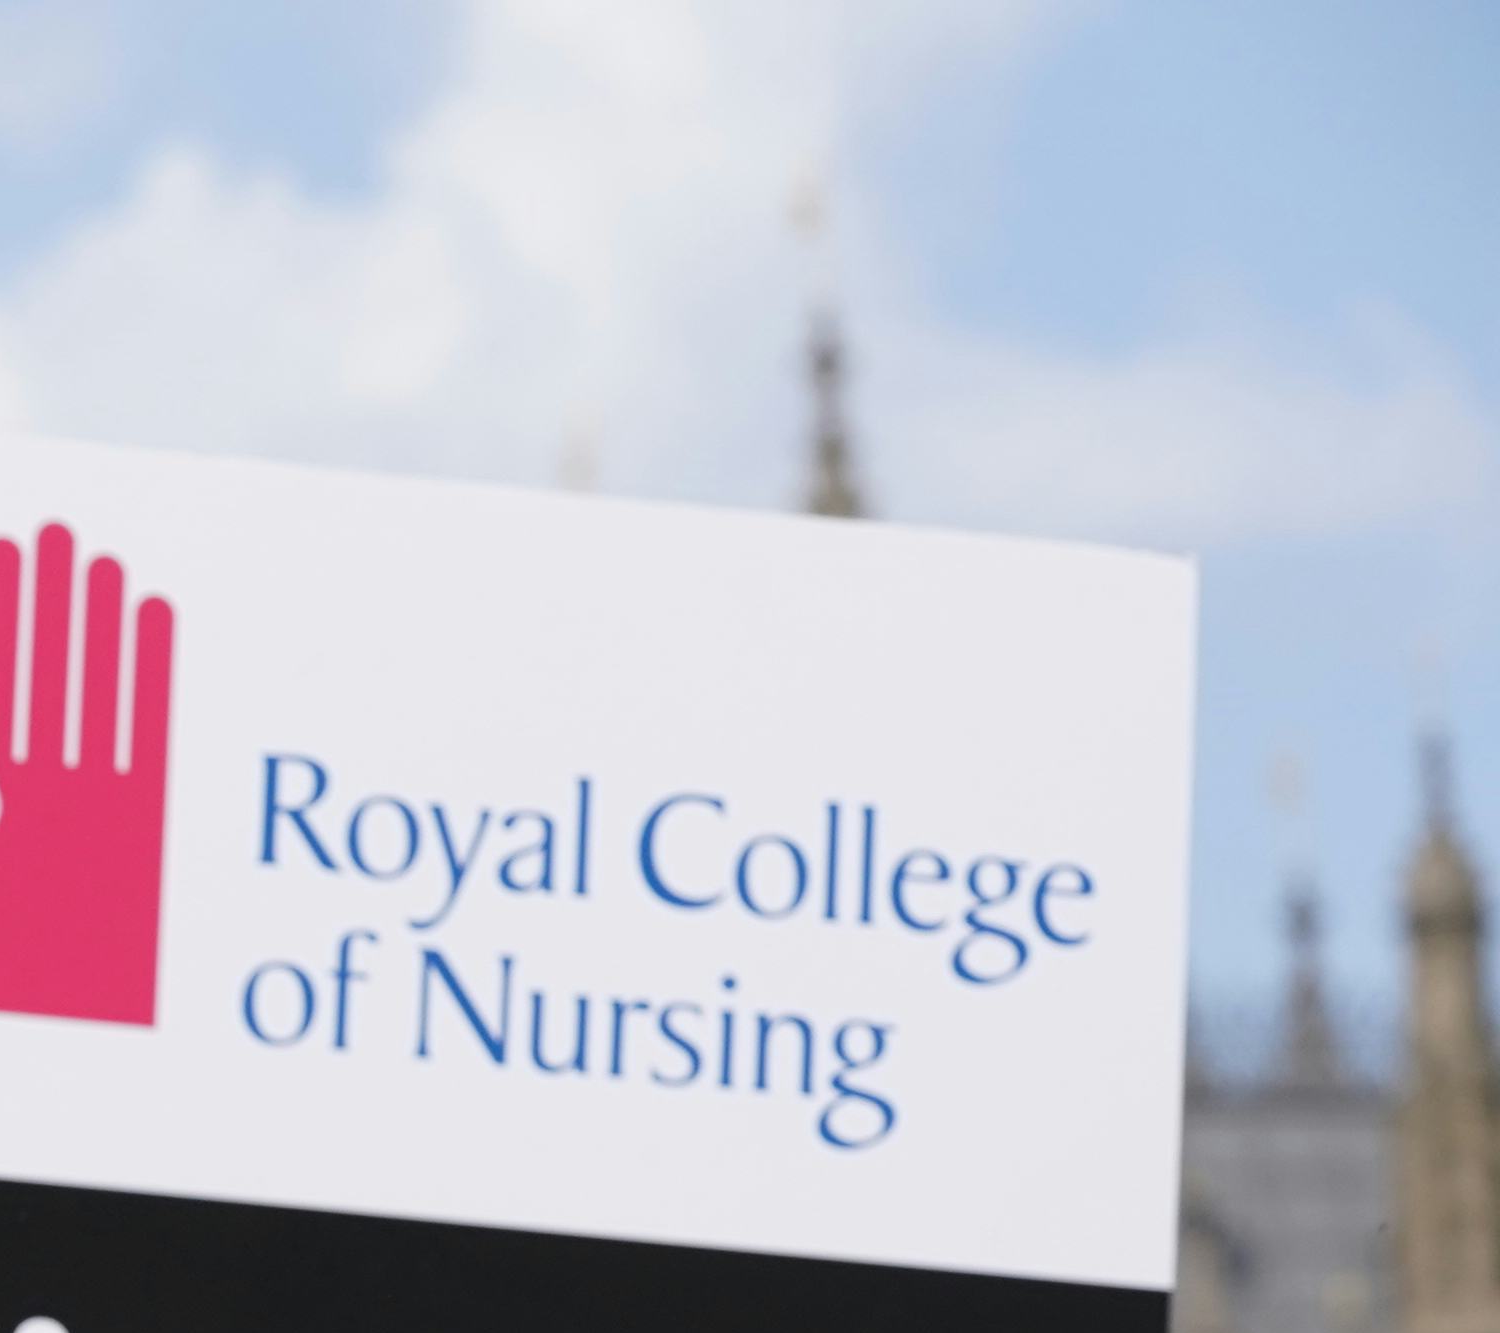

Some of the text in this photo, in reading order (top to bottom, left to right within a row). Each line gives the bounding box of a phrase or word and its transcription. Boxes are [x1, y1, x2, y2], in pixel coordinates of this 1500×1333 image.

[257, 753, 1097, 987] Royal College
[239, 930, 899, 1152] of Nursing
